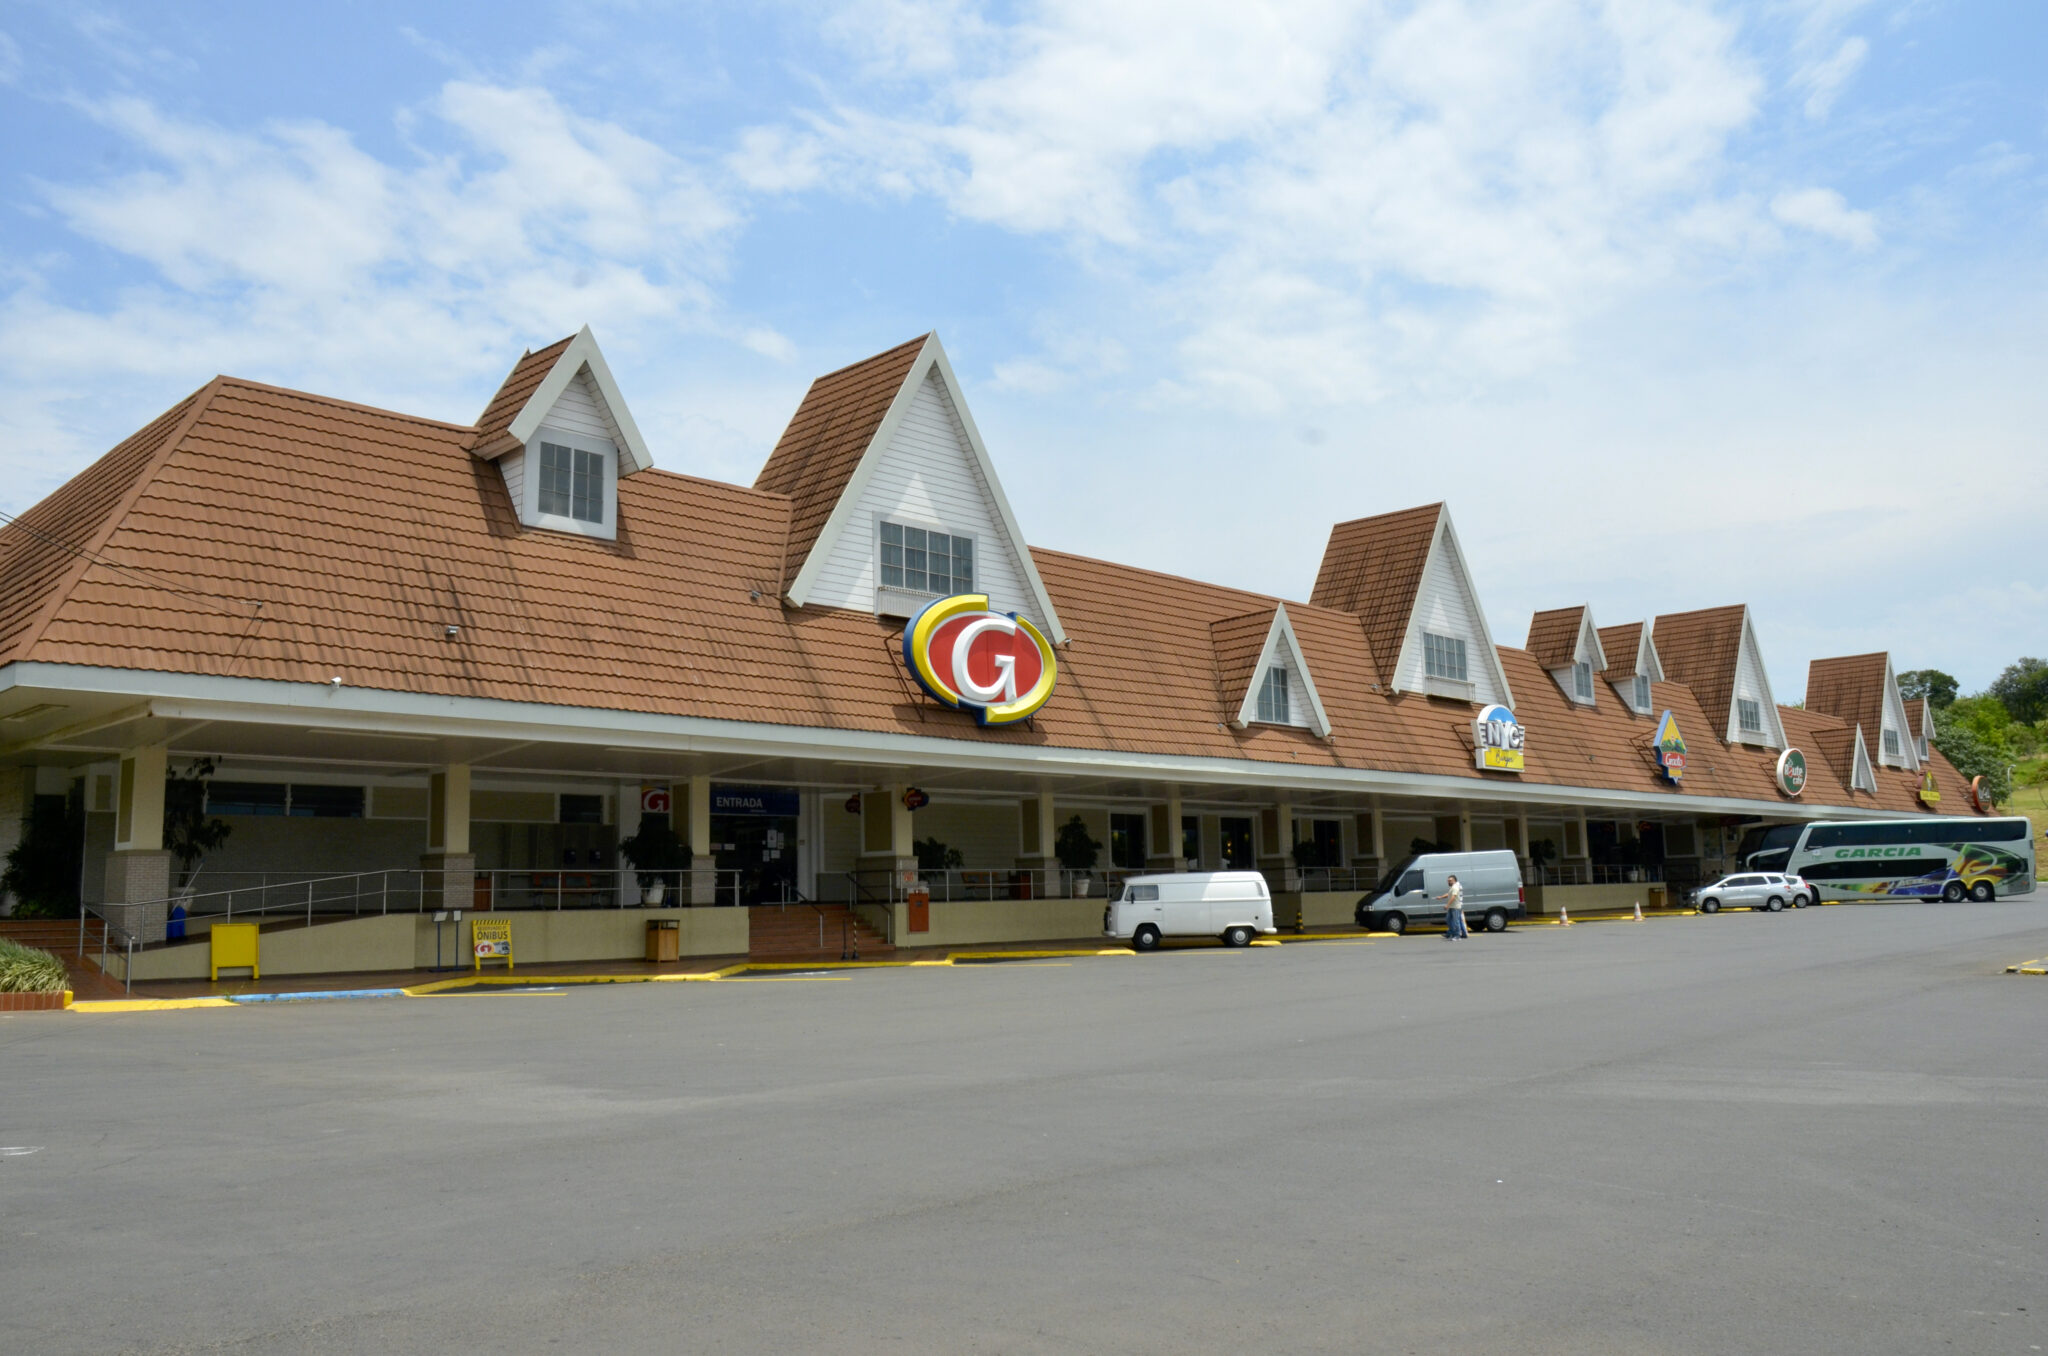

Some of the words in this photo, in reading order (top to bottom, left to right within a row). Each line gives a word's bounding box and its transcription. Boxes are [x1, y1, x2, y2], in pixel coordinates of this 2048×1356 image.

[952, 618, 1017, 703] G
[1486, 719, 1520, 750] NYC
[716, 797, 763, 808] ENTRADA
[1835, 847, 1921, 858] GARCIA
